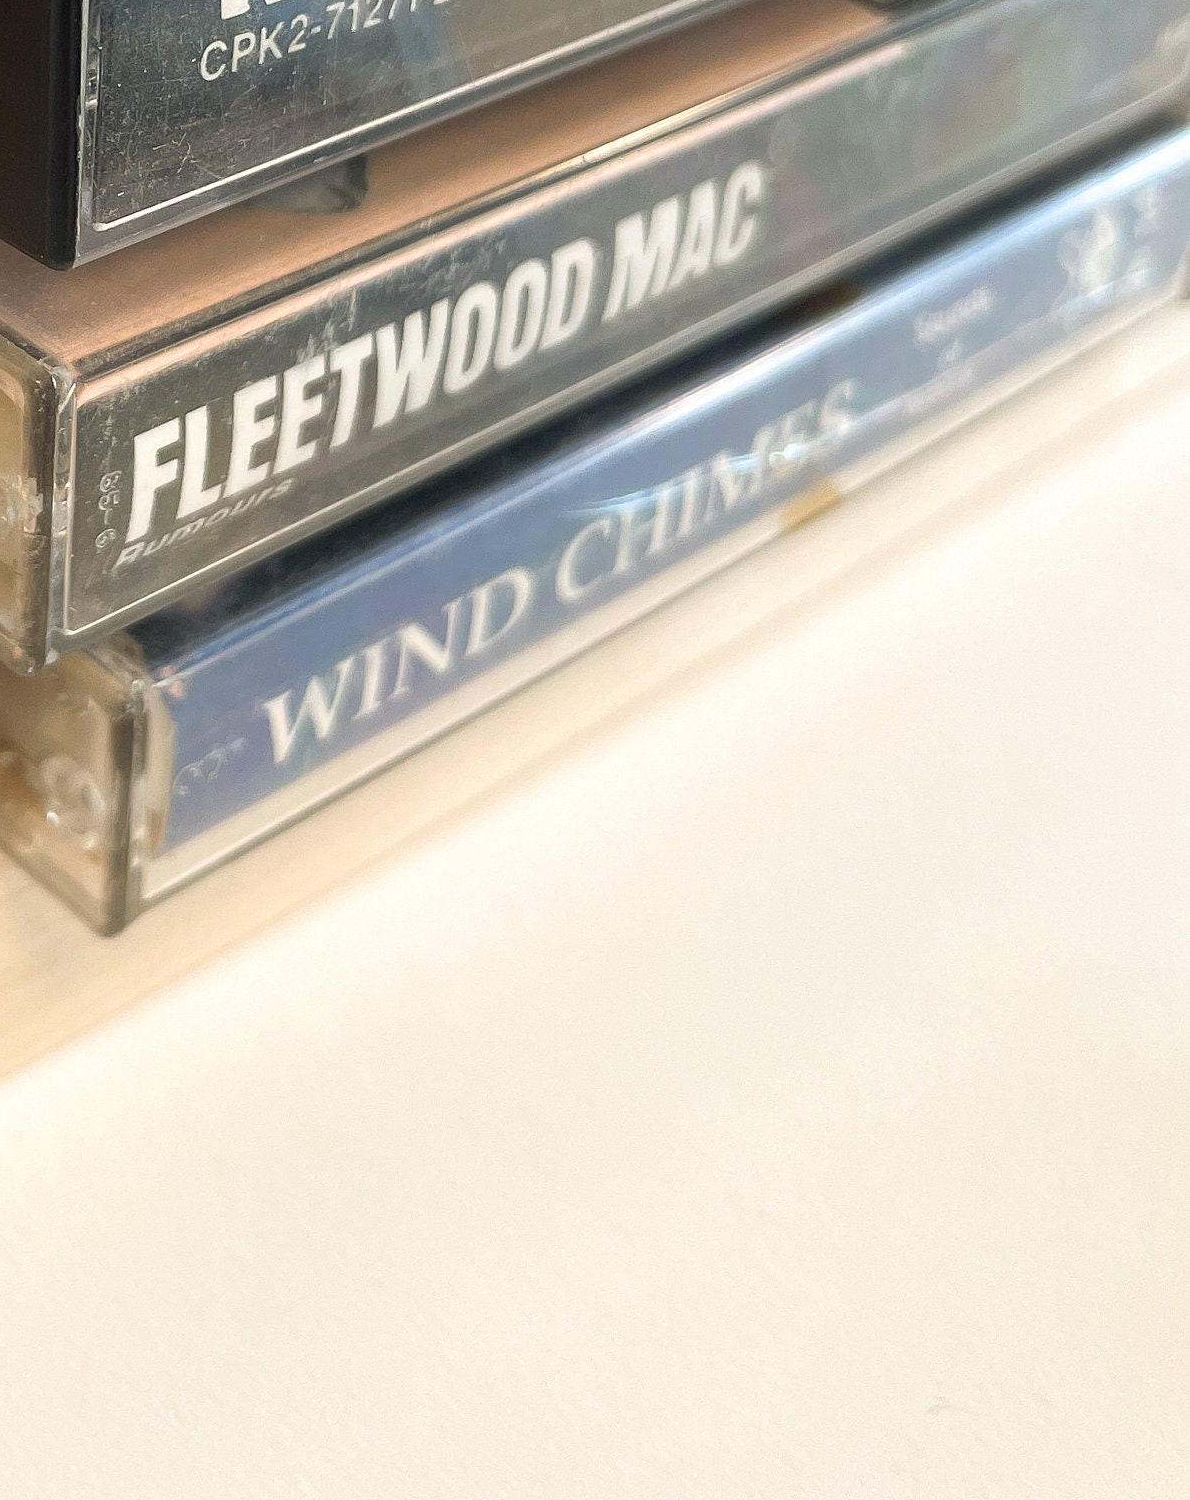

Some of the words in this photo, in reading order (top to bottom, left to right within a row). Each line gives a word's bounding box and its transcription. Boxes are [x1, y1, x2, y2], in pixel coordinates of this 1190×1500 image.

[125, 236, 603, 545] FLEETWOOD
[602, 160, 766, 324] MAC
[262, 566, 536, 767] WIND
[555, 377, 858, 601] CHIMES
